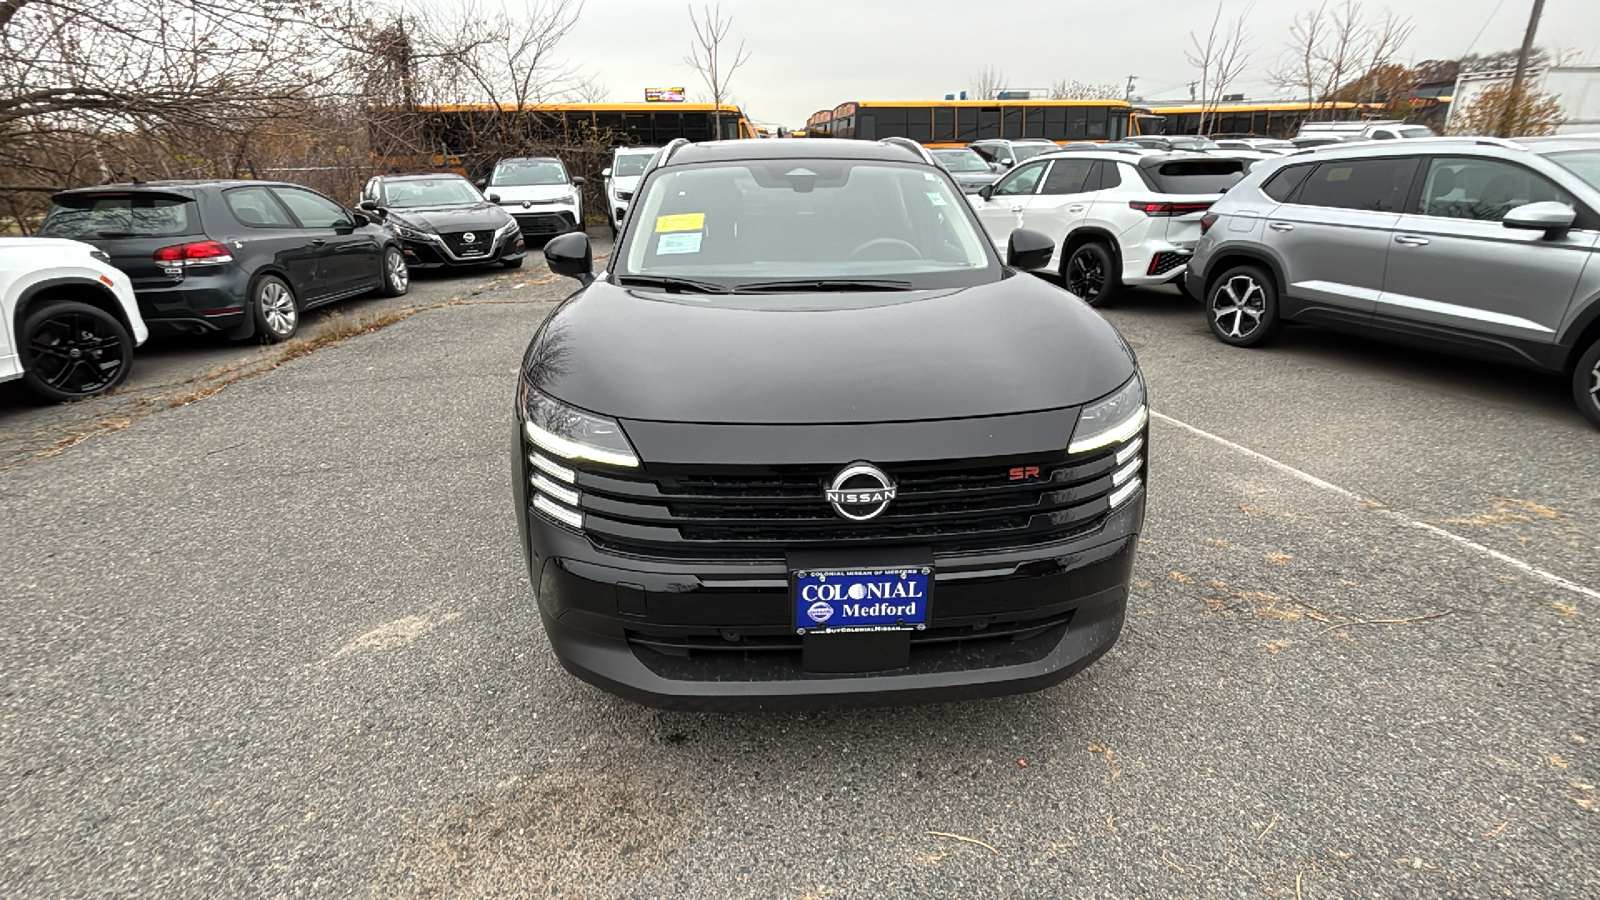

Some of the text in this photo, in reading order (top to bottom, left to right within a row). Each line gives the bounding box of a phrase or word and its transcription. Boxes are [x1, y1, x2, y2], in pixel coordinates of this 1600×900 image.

[1009, 466, 1040, 481] SR
[827, 490, 896, 503] NISSAN
[802, 581, 923, 601] COLONIAL
[842, 602, 916, 617] Medford
